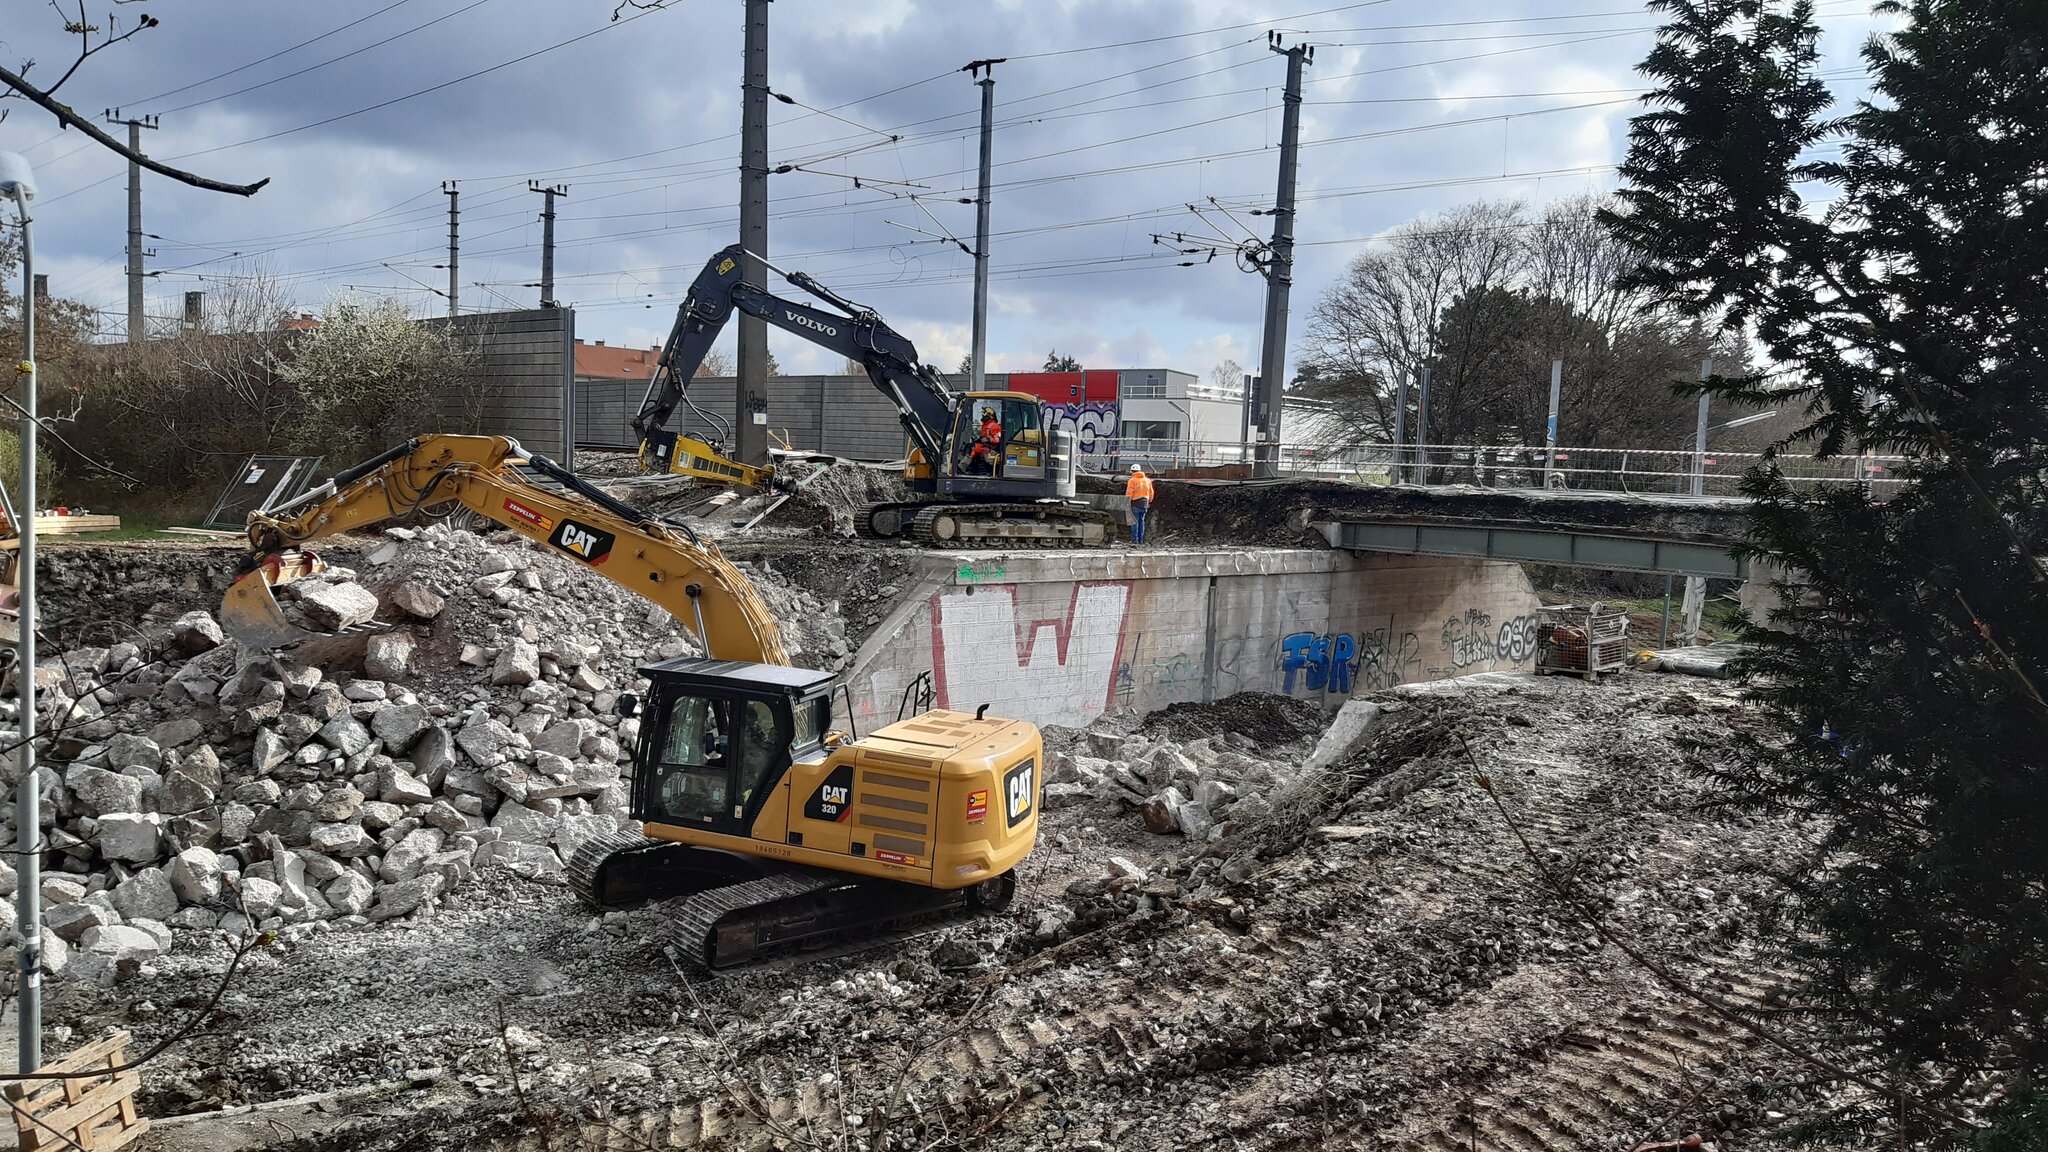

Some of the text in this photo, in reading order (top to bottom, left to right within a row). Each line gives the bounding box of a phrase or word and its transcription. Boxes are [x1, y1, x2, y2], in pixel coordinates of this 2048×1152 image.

[785, 310, 837, 336] VOLVO
[508, 503, 536, 520] ZEPPELIN
[561, 524, 597, 557] CAT
[822, 784, 848, 804] CAT
[1010, 767, 1031, 818] CAT
[821, 803, 837, 814] 320
[880, 853, 901, 861] ZEPPELIN
